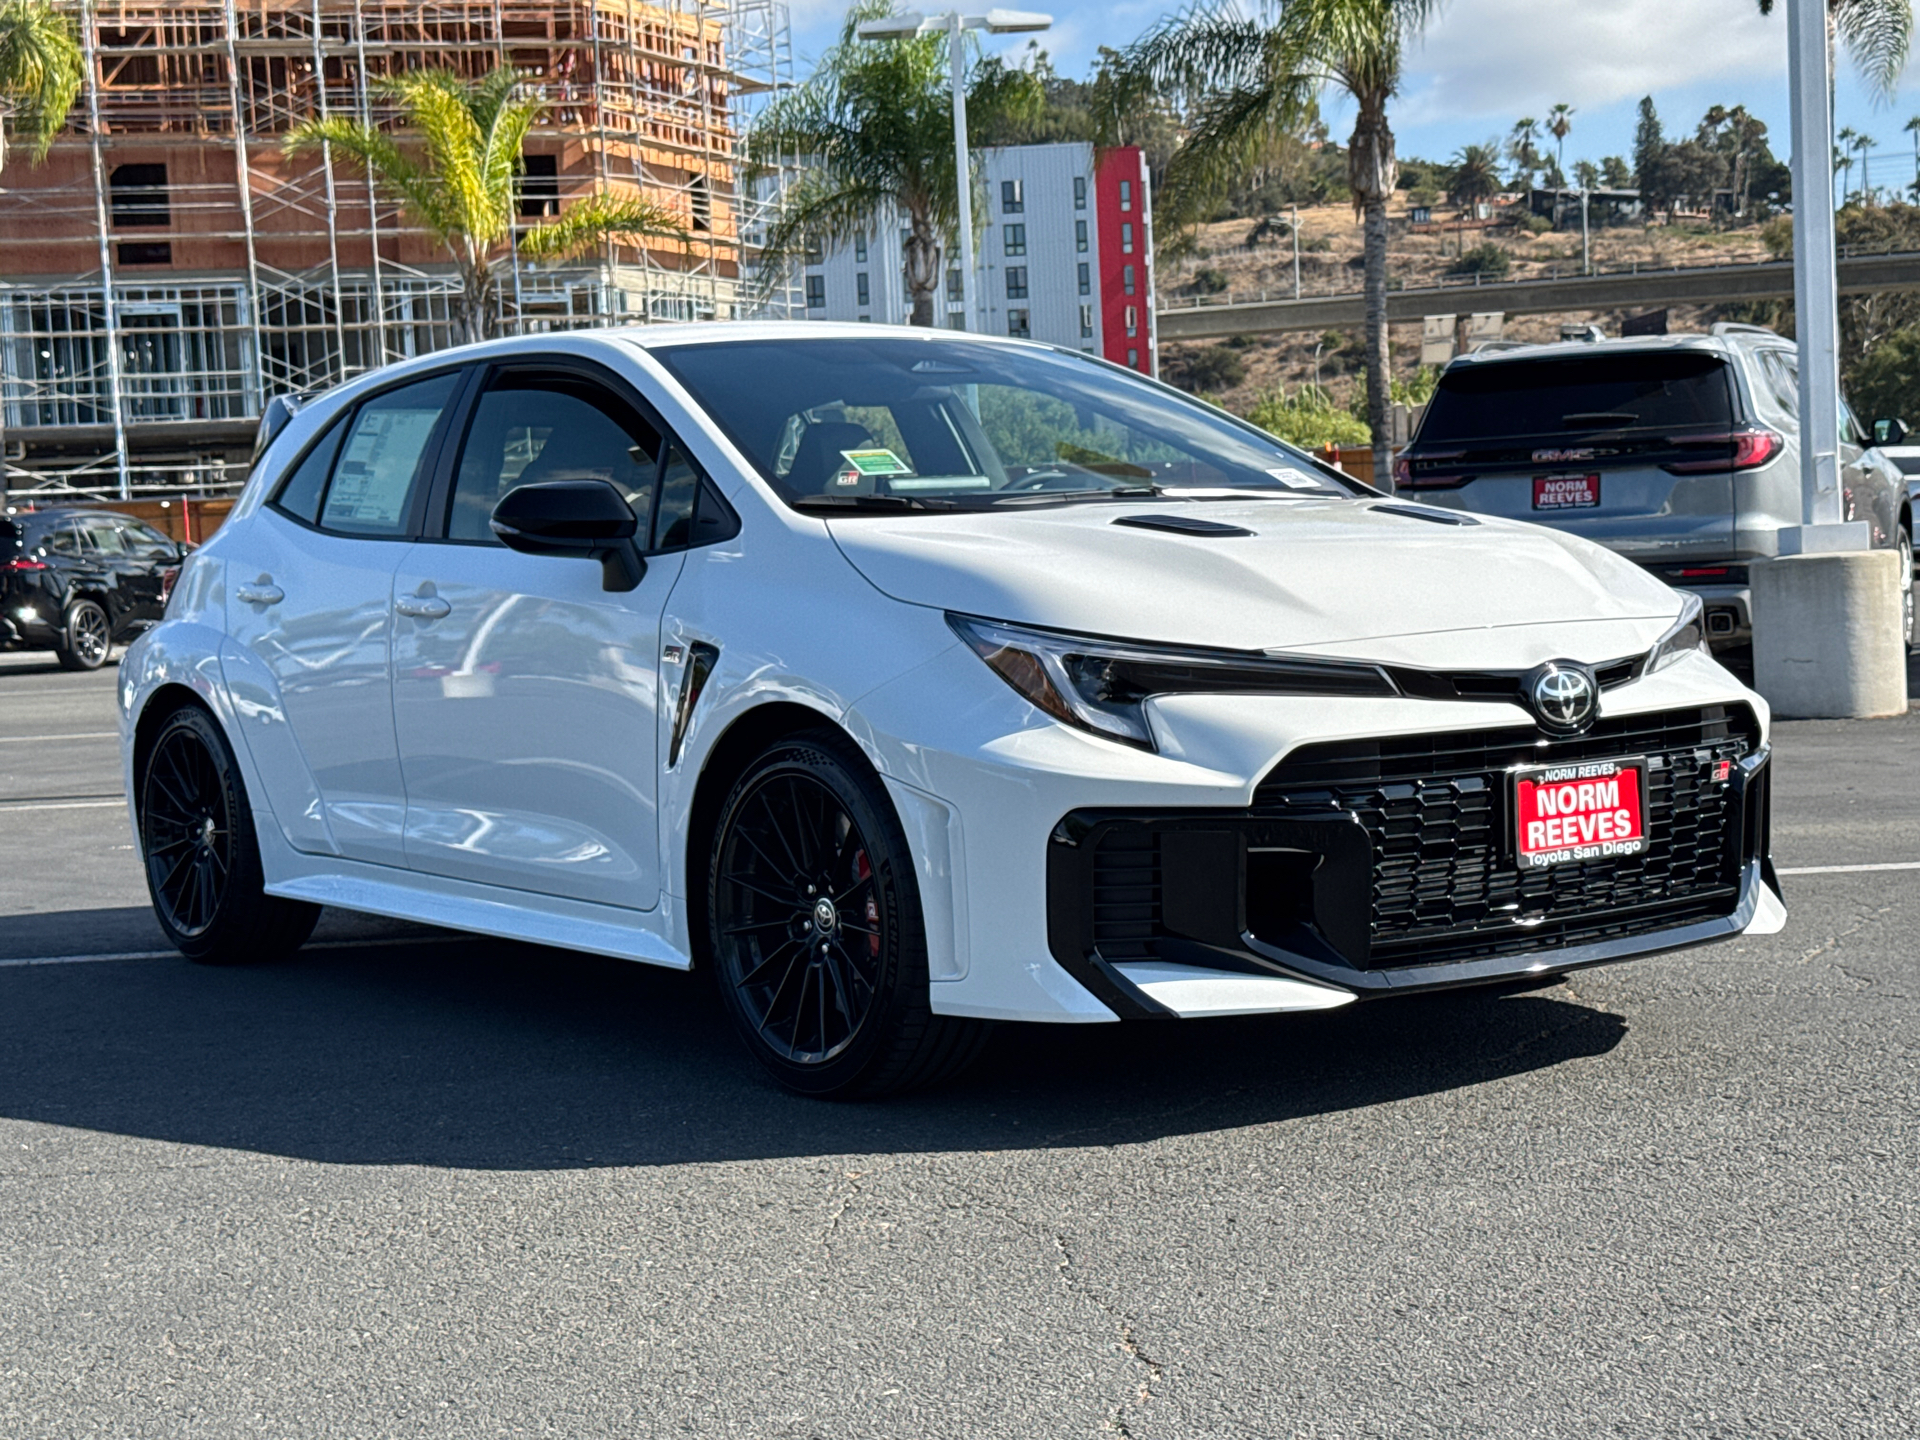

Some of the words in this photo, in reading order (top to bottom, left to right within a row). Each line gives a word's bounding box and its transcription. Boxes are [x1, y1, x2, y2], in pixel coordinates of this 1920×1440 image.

[1532, 448, 1594, 463] GMC
[1545, 480, 1587, 493] NORM
[1539, 490, 1593, 504] REEVES
[1545, 766, 1577, 781] NORM
[1578, 763, 1615, 777] REEVES
[1712, 769, 1728, 780] GR
[1536, 780, 1620, 817] NORM
[1527, 809, 1632, 849] REEVES
[1527, 848, 1571, 867] Toyota
[1573, 844, 1600, 859] San
[1602, 840, 1642, 856] Diego
[886, 890, 899, 988] MICHELIN
